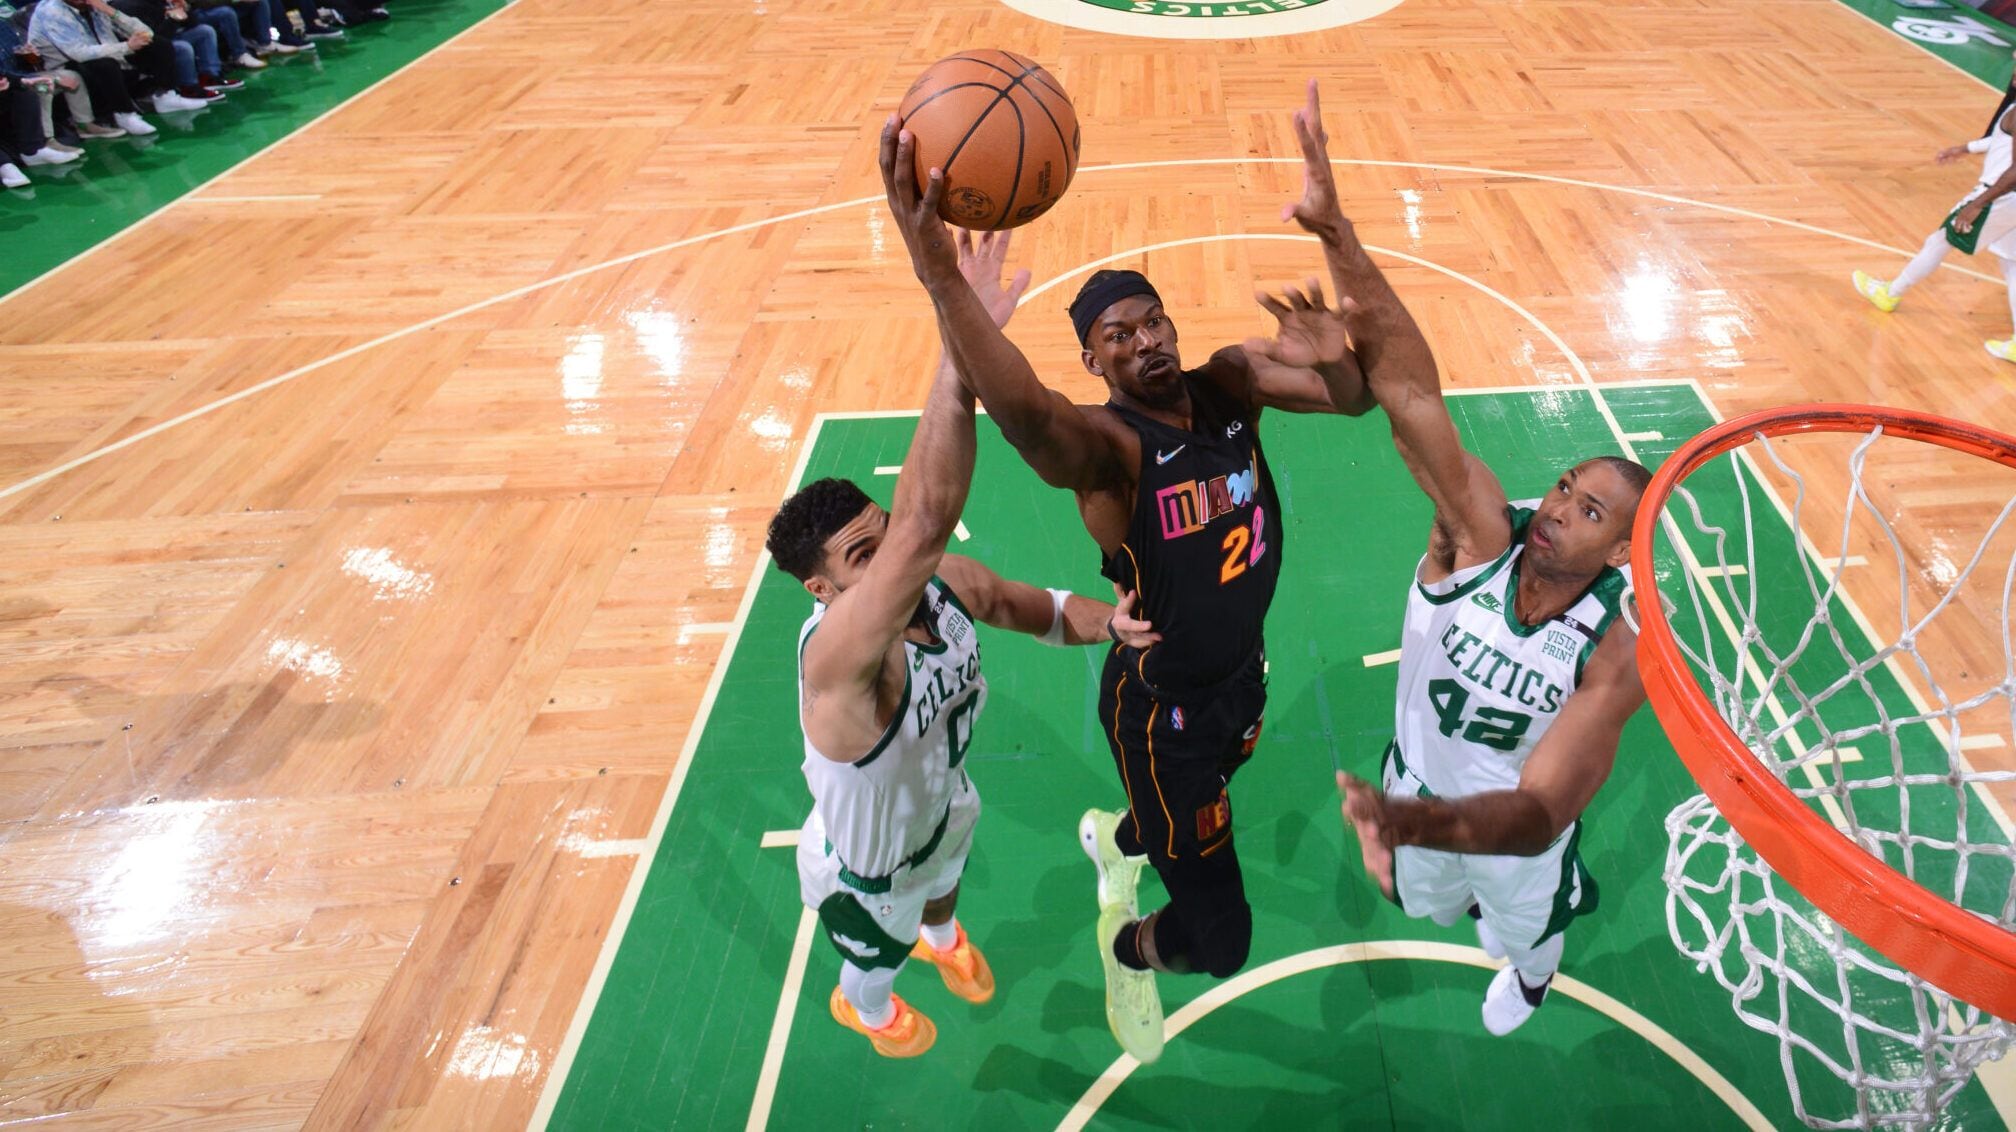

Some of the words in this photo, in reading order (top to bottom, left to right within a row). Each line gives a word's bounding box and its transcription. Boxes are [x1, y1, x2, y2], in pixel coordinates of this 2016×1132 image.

[1227, 420, 1242, 439] KG
[1219, 505, 1266, 586] 22
[945, 612, 965, 637] VISTA
[952, 620, 969, 647] PRINT
[1564, 617, 1578, 629] 24
[1542, 643, 1573, 664] PRINT
[1547, 630, 1577, 655] VISTA
[1441, 623, 1563, 713] CELTICS
[1428, 678, 1532, 751] 42
